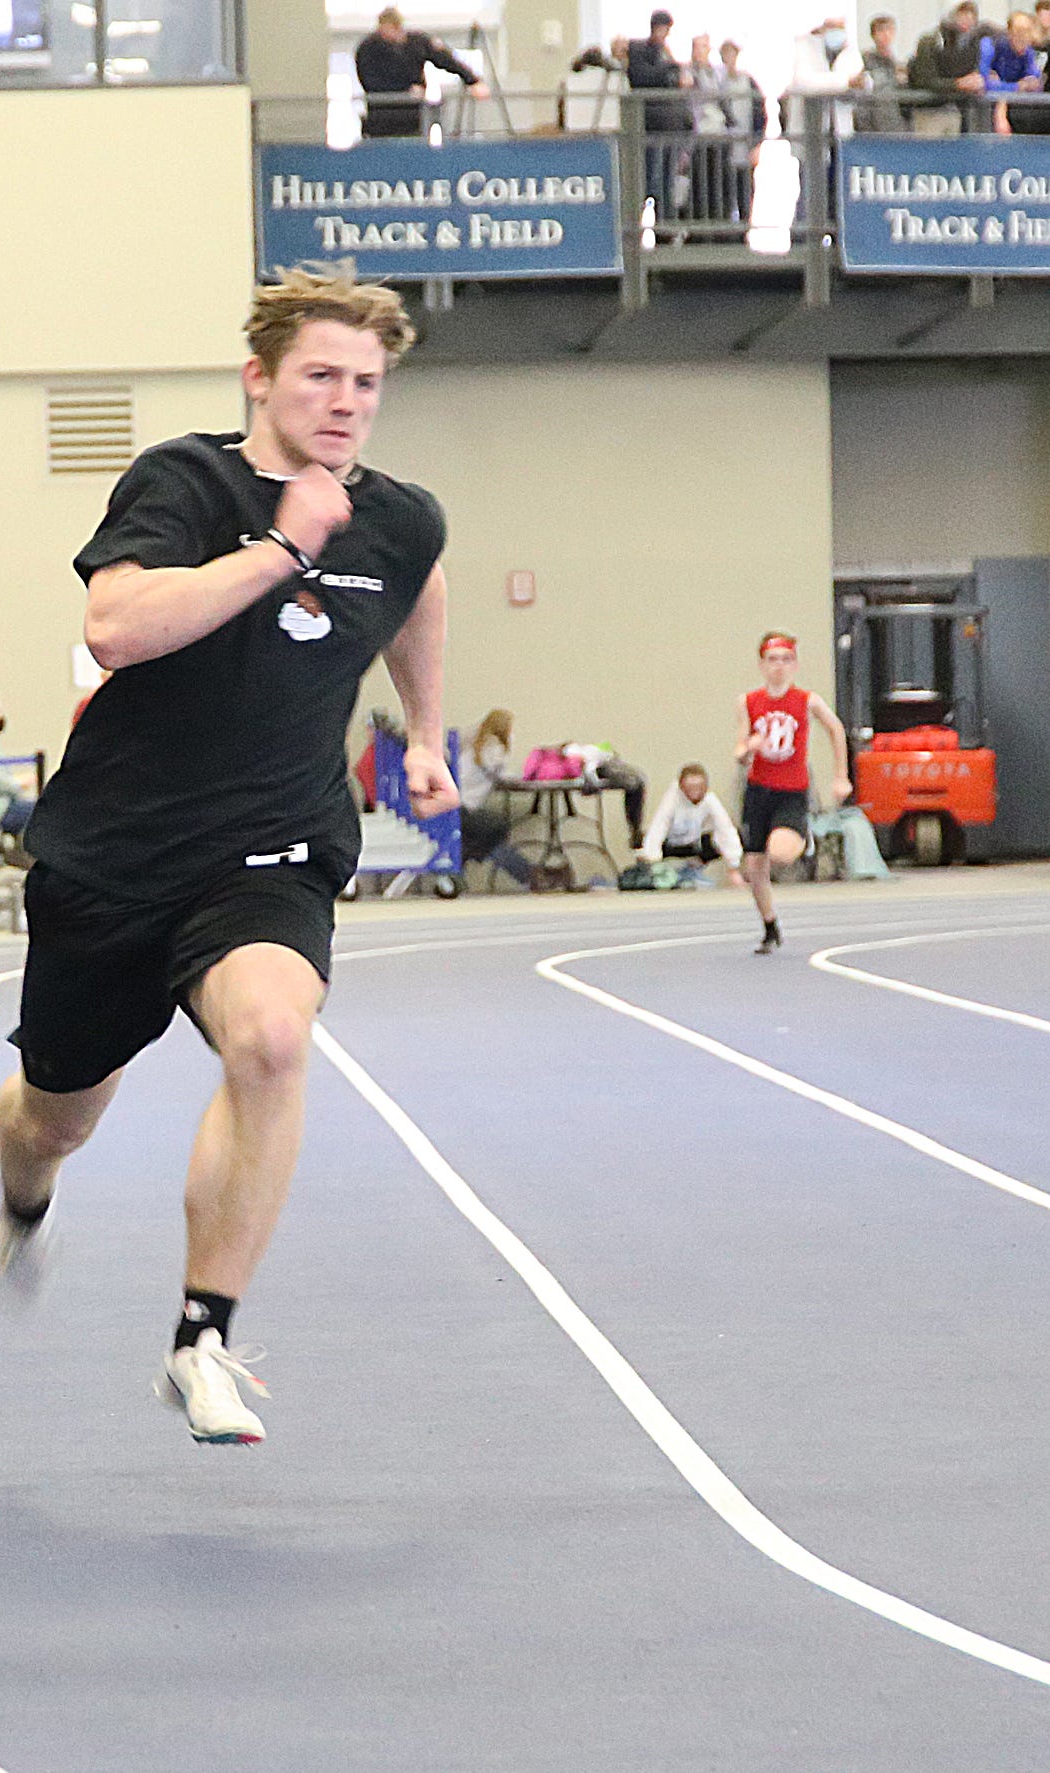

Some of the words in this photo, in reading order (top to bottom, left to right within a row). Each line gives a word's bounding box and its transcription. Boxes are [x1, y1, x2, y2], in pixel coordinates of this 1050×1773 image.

[271, 173, 452, 208] HILLSDALE
[457, 170, 606, 206] COLLEGE
[849, 165, 998, 202] HILLSDALE
[315, 215, 429, 250] TRACK
[435, 220, 462, 249] &
[469, 213, 564, 248] FIELD
[884, 207, 979, 245] TRACK
[983, 215, 1004, 244] &
[880, 762, 971, 780] TOYOTA
